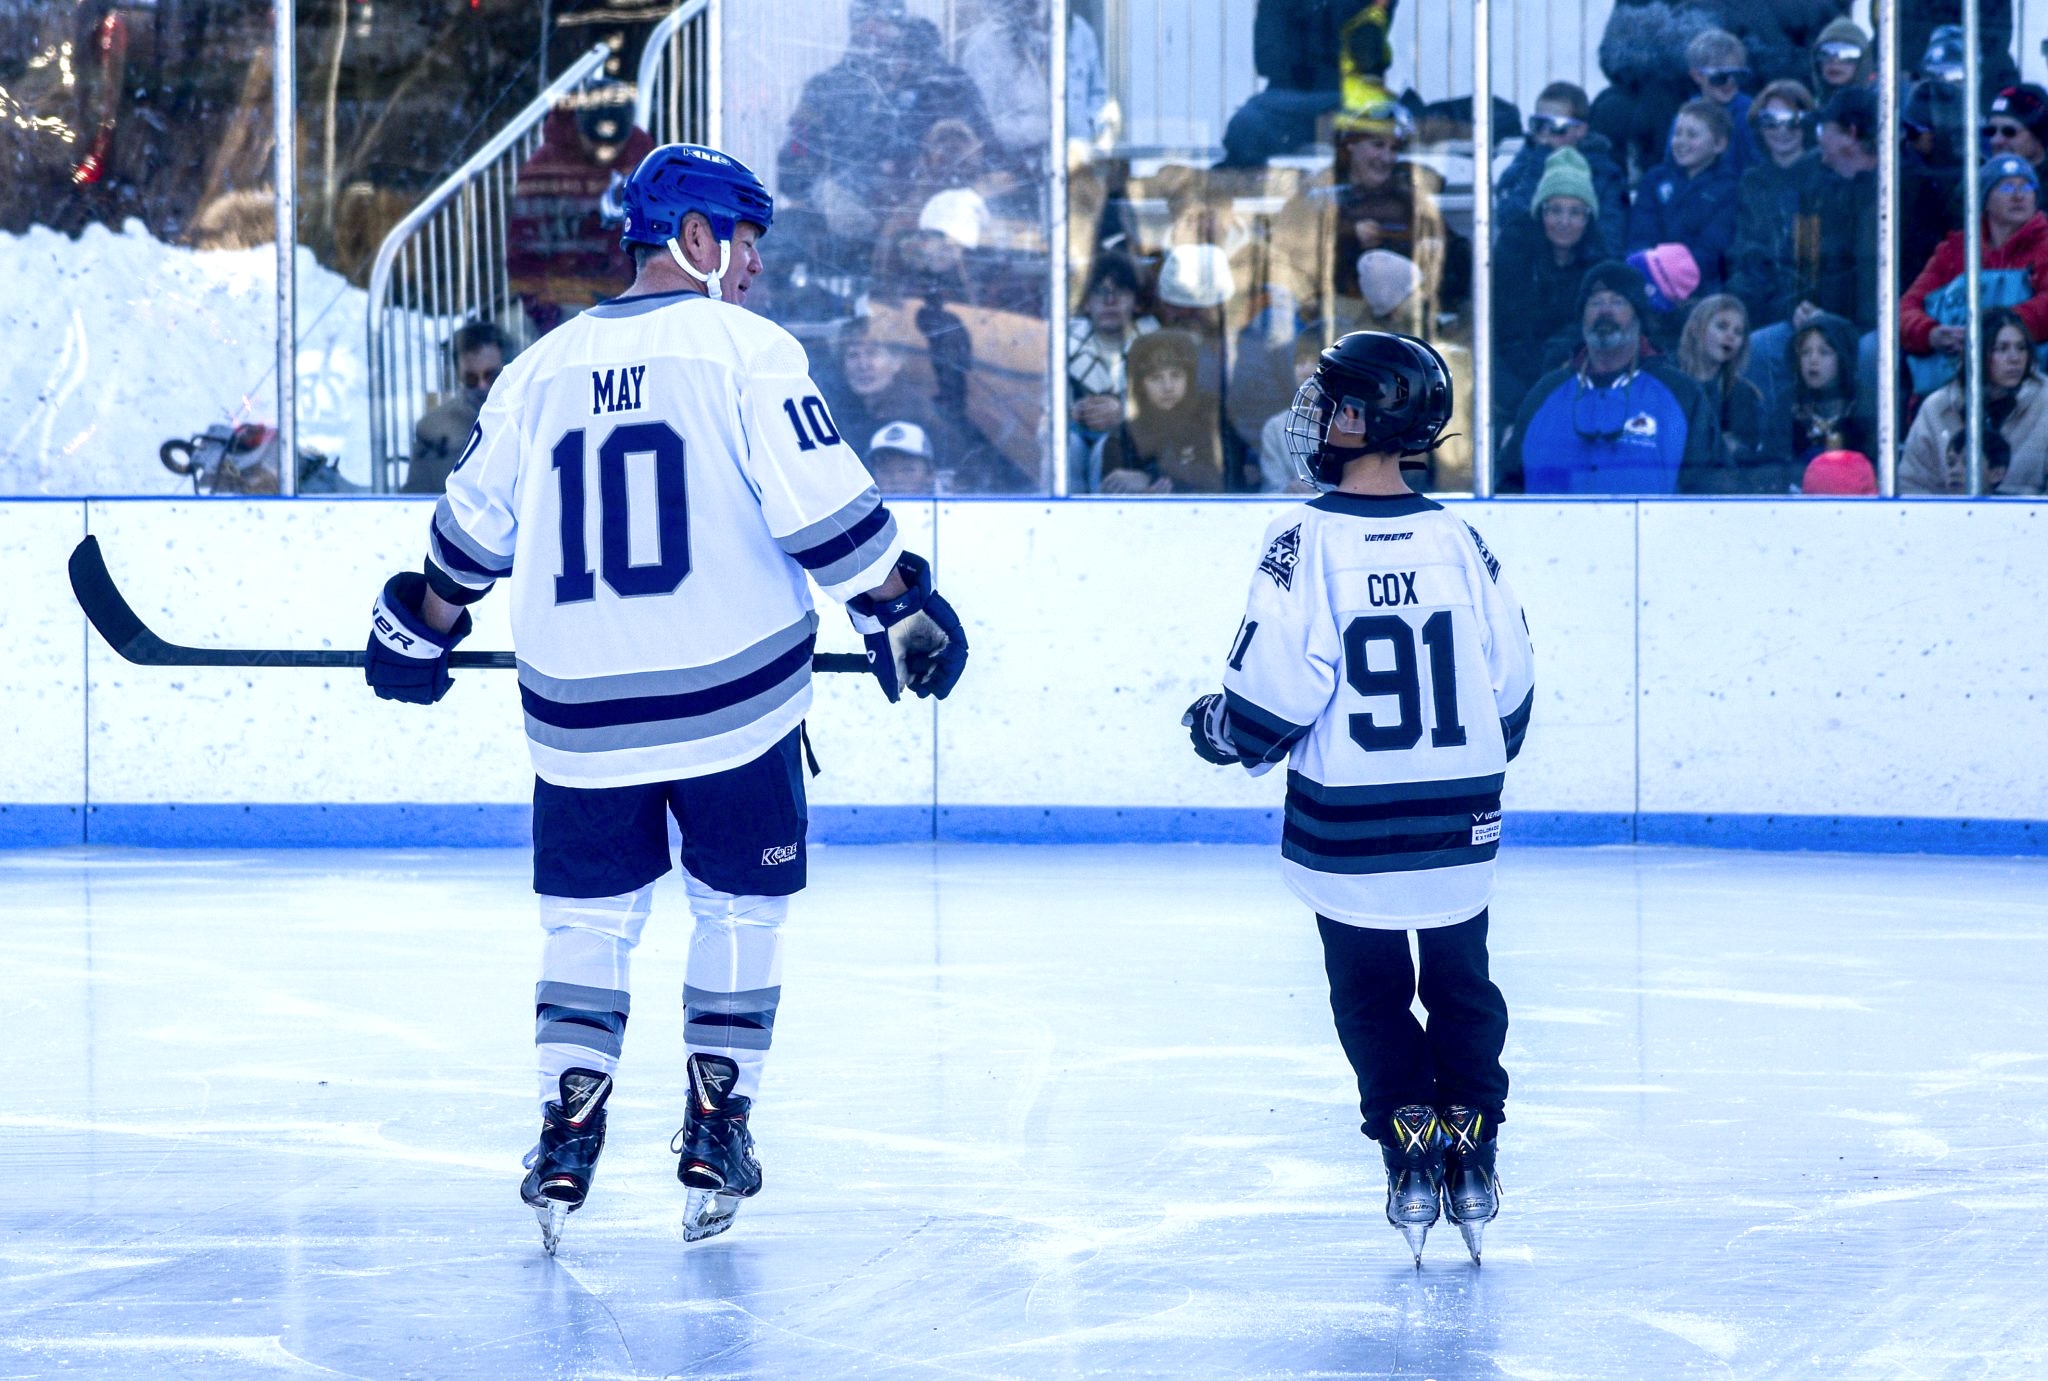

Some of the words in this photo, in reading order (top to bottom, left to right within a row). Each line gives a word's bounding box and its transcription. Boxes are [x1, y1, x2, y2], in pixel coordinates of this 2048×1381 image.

[592, 365, 646, 414] MAY
[783, 396, 841, 450] 10
[551, 420, 693, 606] 10
[1364, 532, 1414, 542] VERBERO
[1367, 571, 1419, 607] COX
[1342, 611, 1467, 752] 91
